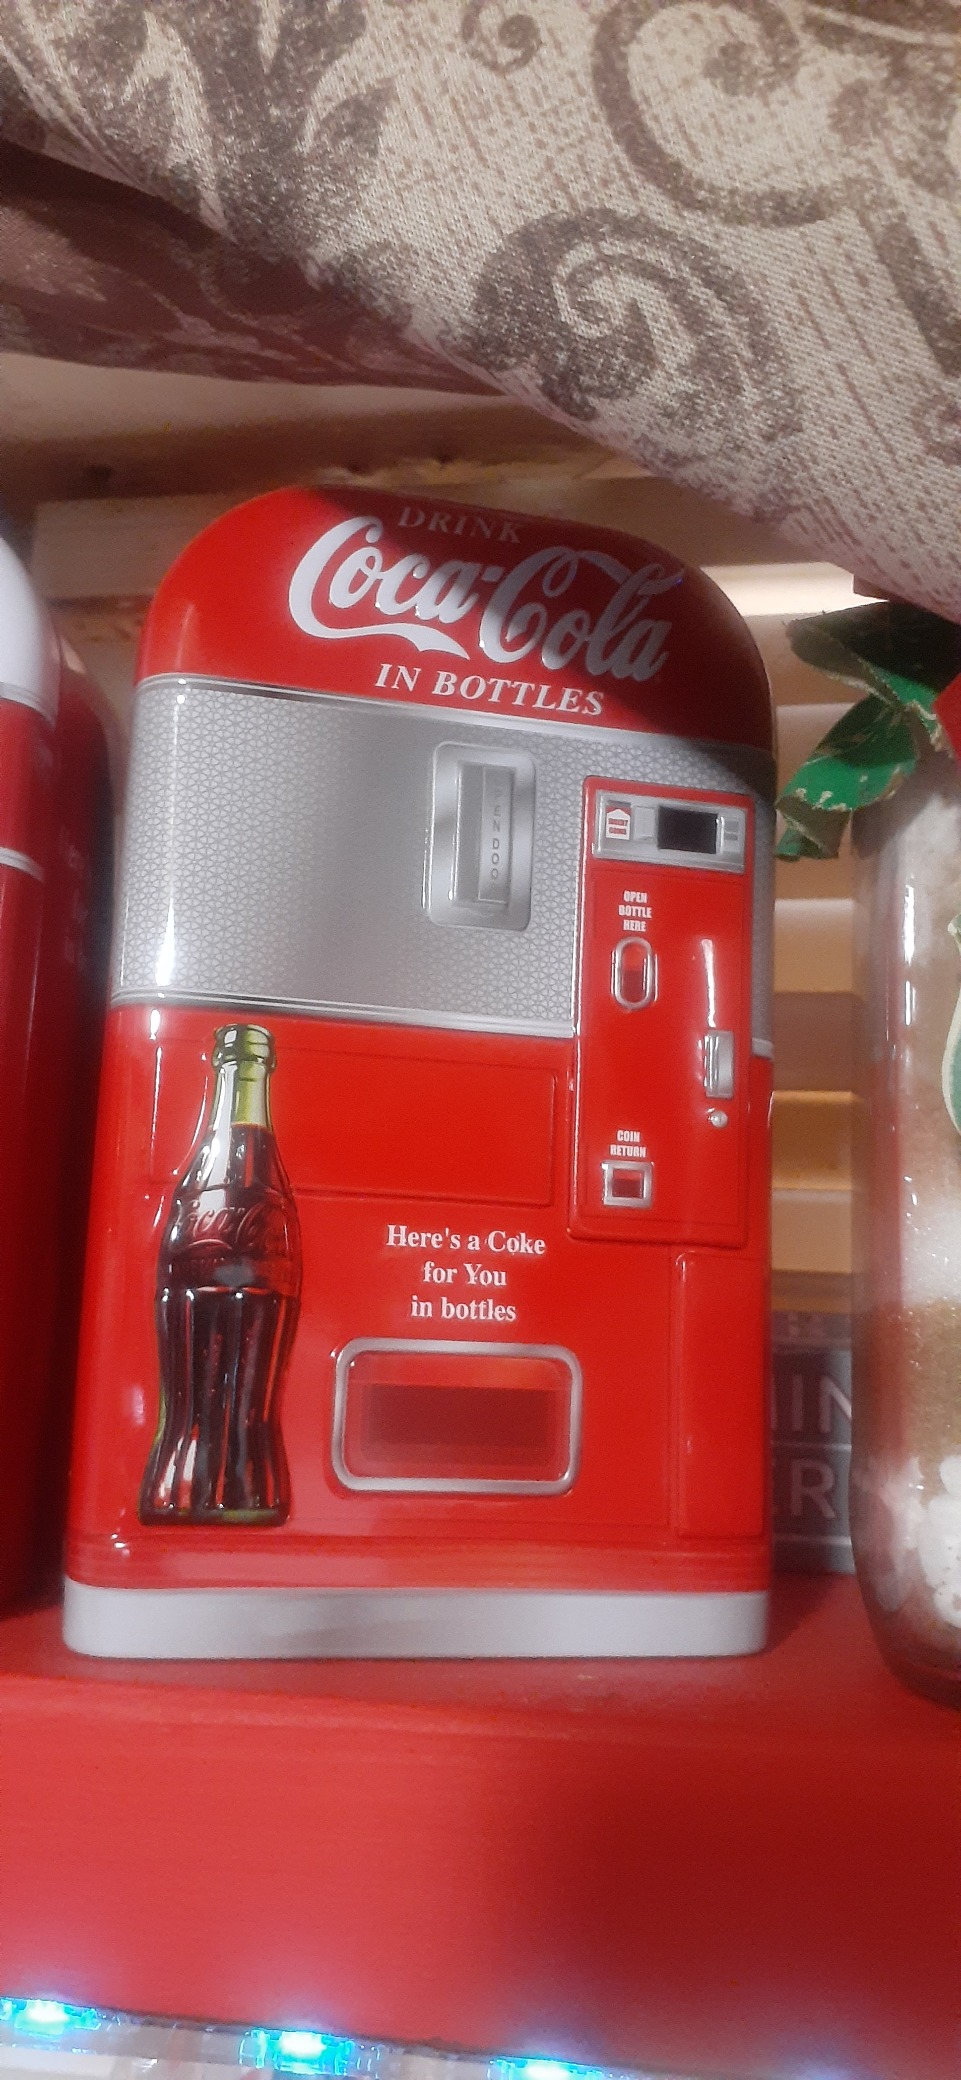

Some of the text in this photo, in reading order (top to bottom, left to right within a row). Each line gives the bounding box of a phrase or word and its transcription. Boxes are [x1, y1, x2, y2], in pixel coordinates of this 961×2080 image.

[398, 507, 522, 545] DRINK
[288, 515, 684, 683] Coca-Cola
[374, 663, 606, 717] IN BOTTLES
[623, 889, 648, 904] OPEN
[618, 904, 653, 919] BOTTLE
[622, 919, 647, 932] HERE
[616, 1129, 641, 1143] COIN
[609, 1144, 647, 1158] RETURN
[386, 1224, 546, 1255] Here's a Coke
[423, 1260, 507, 1287] for You
[410, 1294, 517, 1322] in bottles
